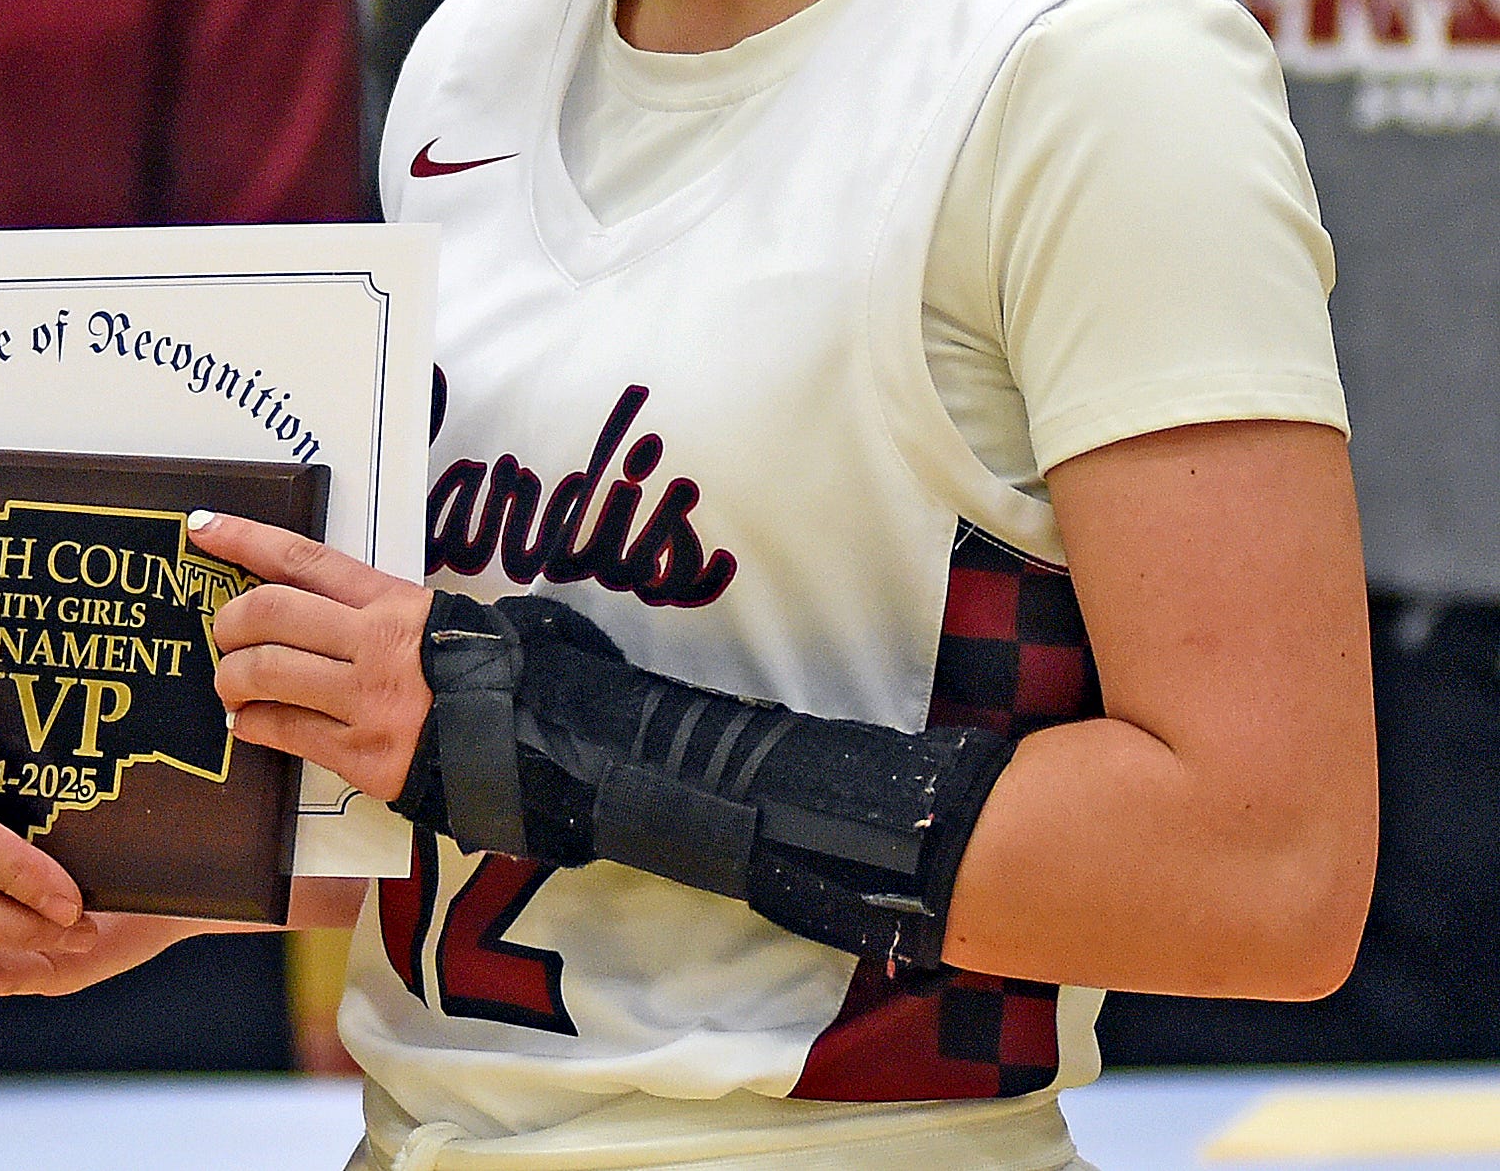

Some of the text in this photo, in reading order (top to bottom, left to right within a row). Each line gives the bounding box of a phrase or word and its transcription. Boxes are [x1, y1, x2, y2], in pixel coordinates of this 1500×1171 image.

[32, 309, 69, 362] of
[88, 310, 320, 464] Recognition
[424, 362, 738, 608] ardis
[57, 596, 146, 628] GIRLS
